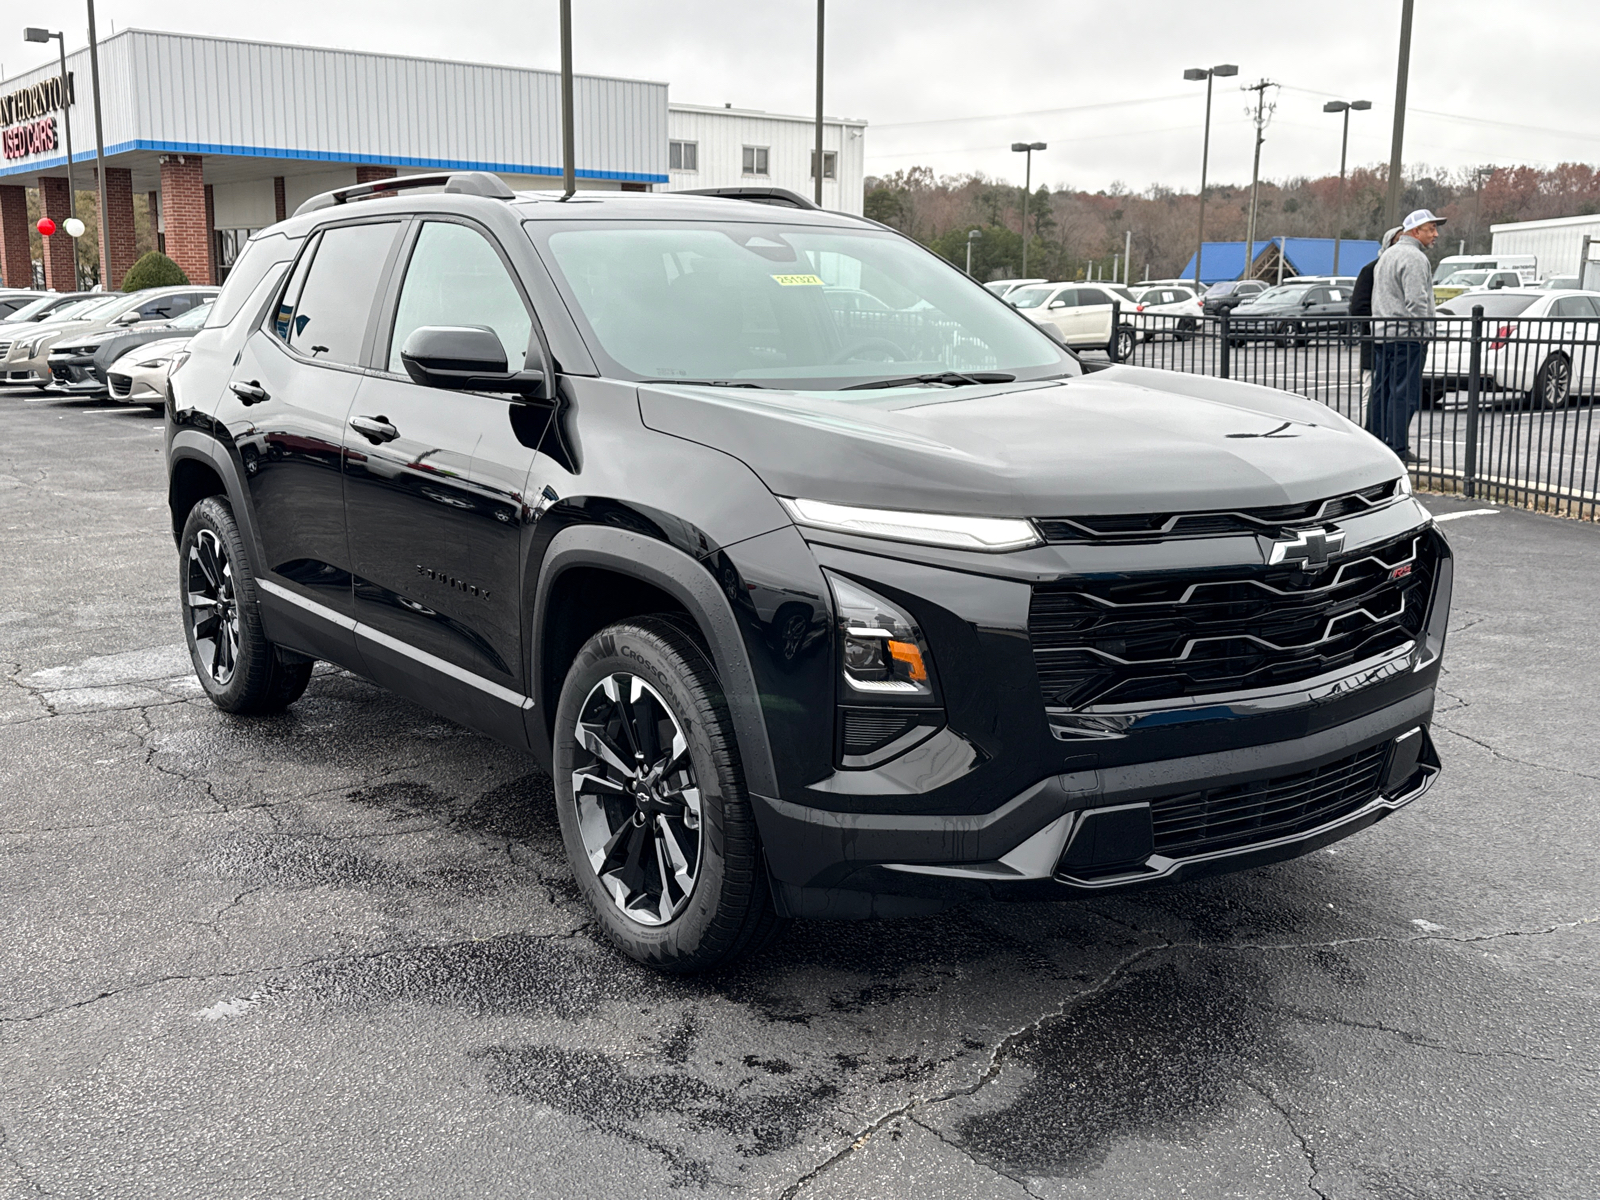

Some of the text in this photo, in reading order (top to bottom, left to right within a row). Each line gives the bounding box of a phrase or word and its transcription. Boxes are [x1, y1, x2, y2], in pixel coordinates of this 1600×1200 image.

[3, 116, 58, 160] USED CARS
[416, 564, 491, 601] EQUINOX
[1393, 564, 1412, 579] RS
